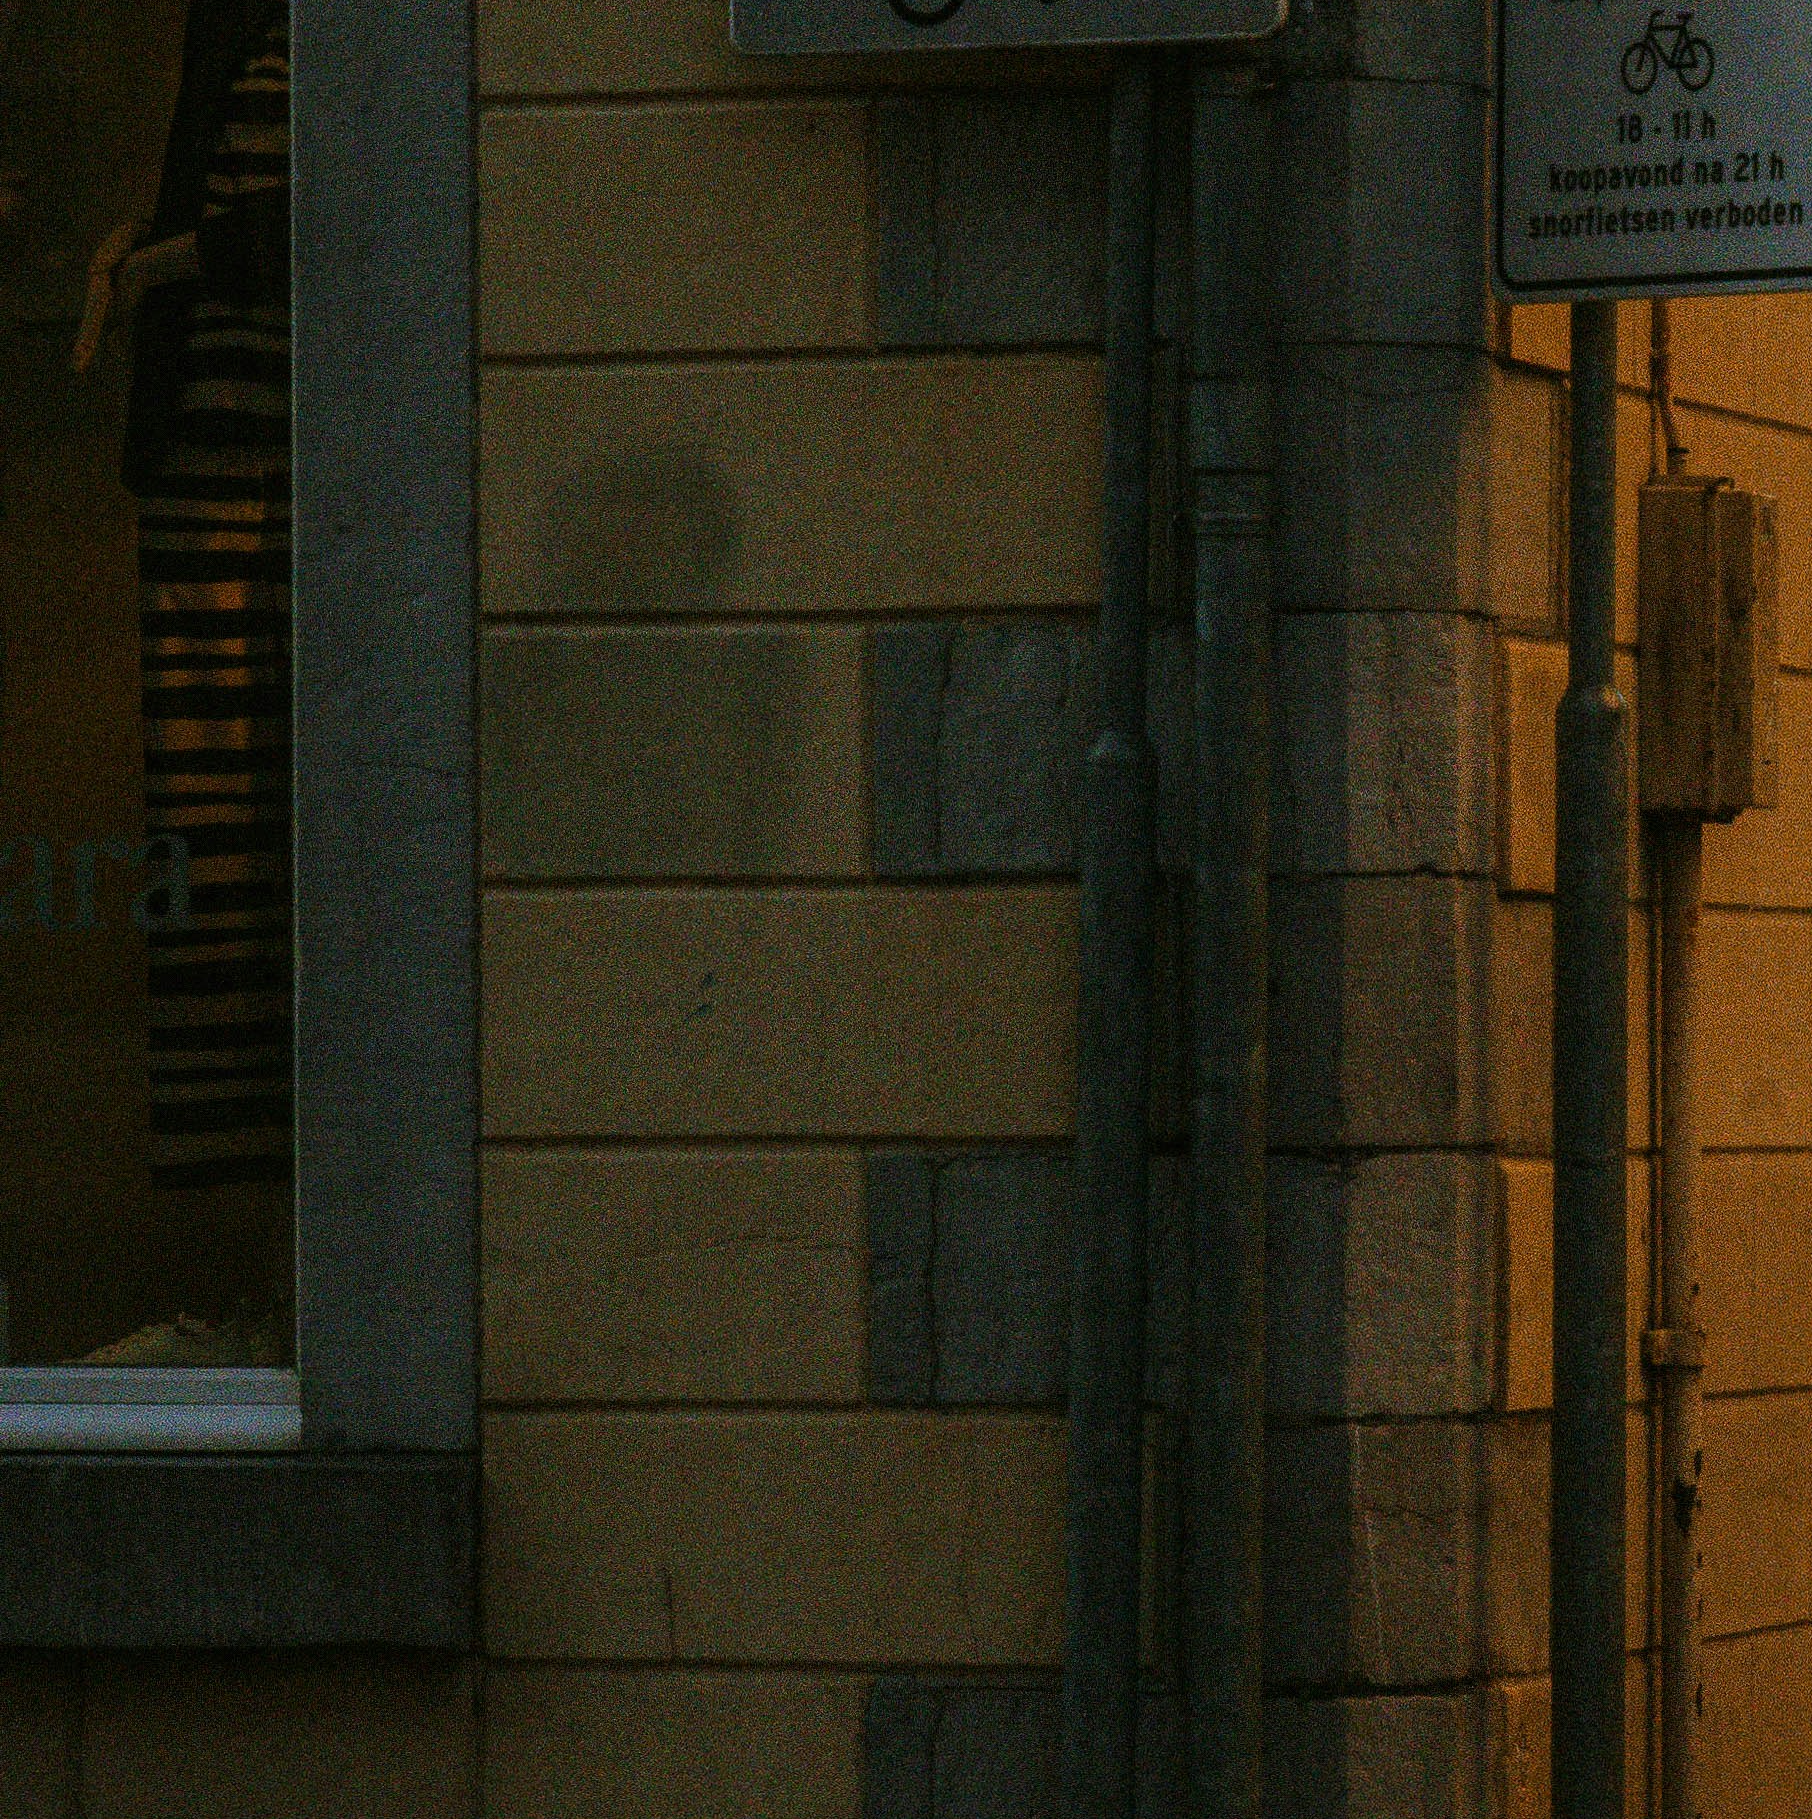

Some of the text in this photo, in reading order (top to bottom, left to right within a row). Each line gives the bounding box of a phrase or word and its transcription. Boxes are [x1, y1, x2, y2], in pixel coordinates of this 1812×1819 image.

[1617, 113, 1643, 144] 18
[1672, 111, 1691, 140] 11
[1701, 110, 1716, 139] h
[1549, 150, 1785, 195] koopavond na 21 h
[1529, 196, 1803, 238] snorfietsen verboden
